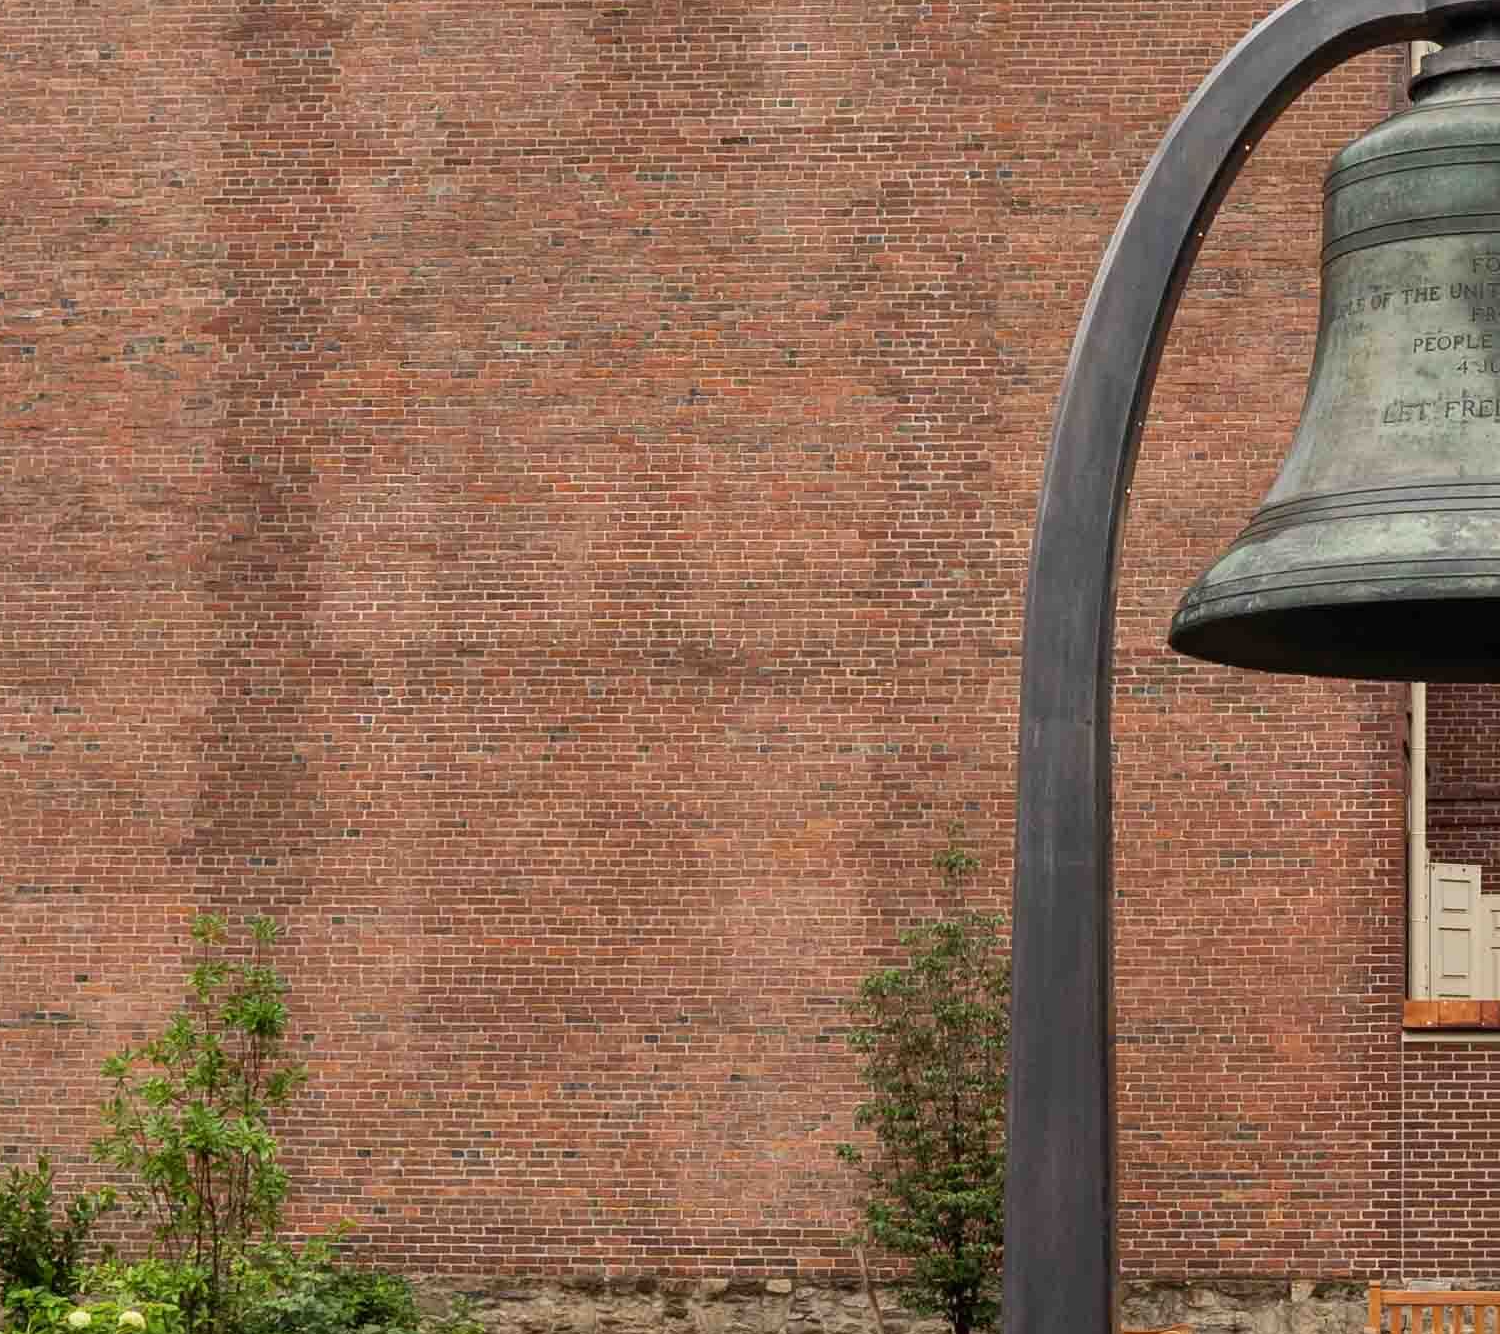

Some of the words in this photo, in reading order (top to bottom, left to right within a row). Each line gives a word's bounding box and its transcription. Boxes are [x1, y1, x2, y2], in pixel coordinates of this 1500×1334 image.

[1371, 291, 1394, 311] OF
[1401, 285, 1441, 305] THE
[1412, 332, 1494, 354] PEOPLE
[1456, 359, 1468, 374] 4
[1382, 402, 1432, 424] LET
